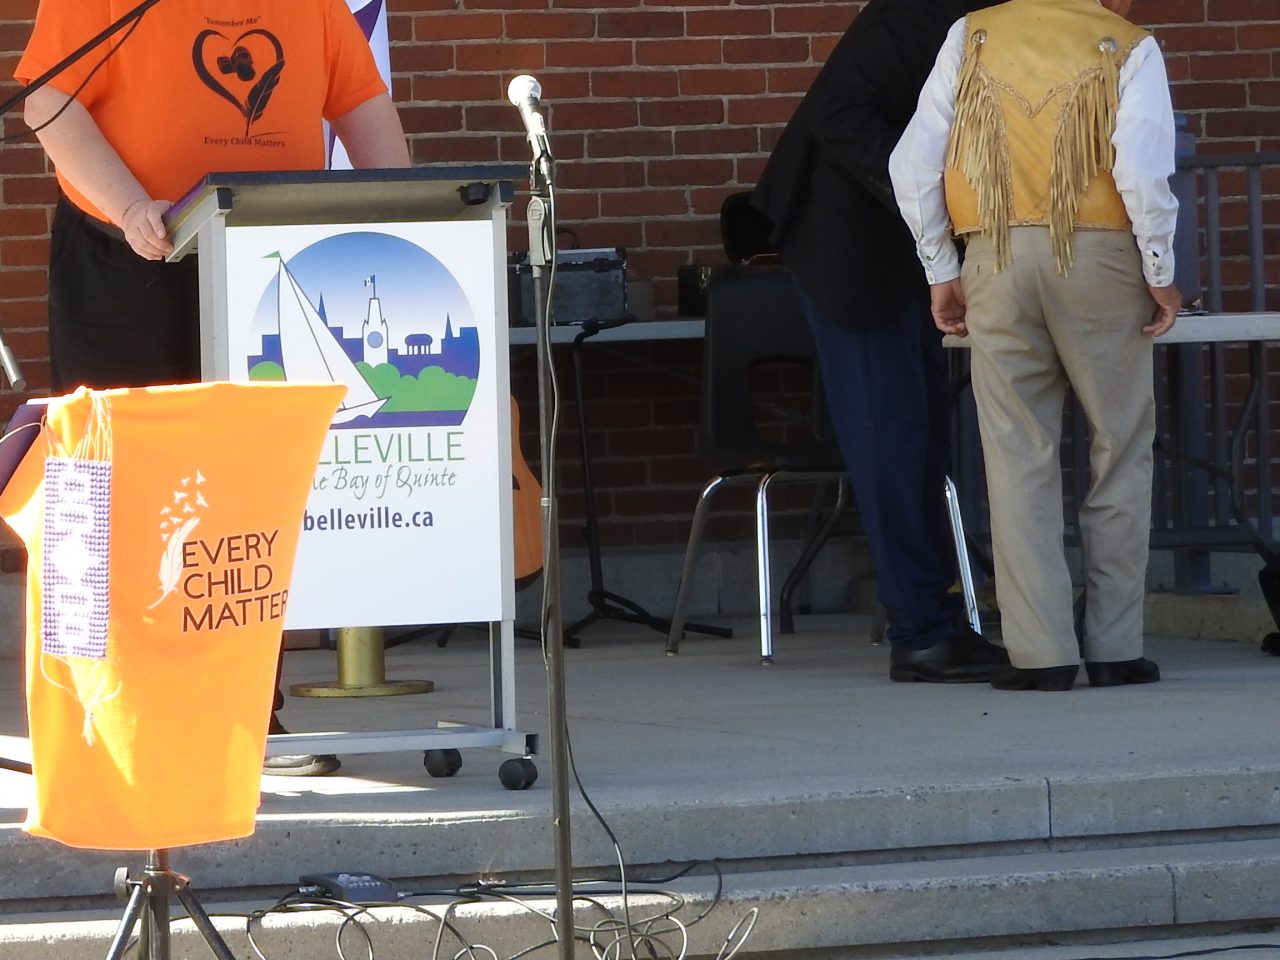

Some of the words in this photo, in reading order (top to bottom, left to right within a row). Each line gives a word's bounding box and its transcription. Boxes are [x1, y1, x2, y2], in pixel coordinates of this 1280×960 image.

[204, 136, 228, 147] Every
[231, 137, 252, 145] Child
[254, 138, 286, 148] Matters
[332, 465, 370, 501] Bay
[375, 464, 394, 499] of
[396, 465, 457, 498] Quinte
[303, 506, 434, 531] belleville.ca
[182, 529, 279, 568] EVERY
[183, 564, 273, 599] CHILD
